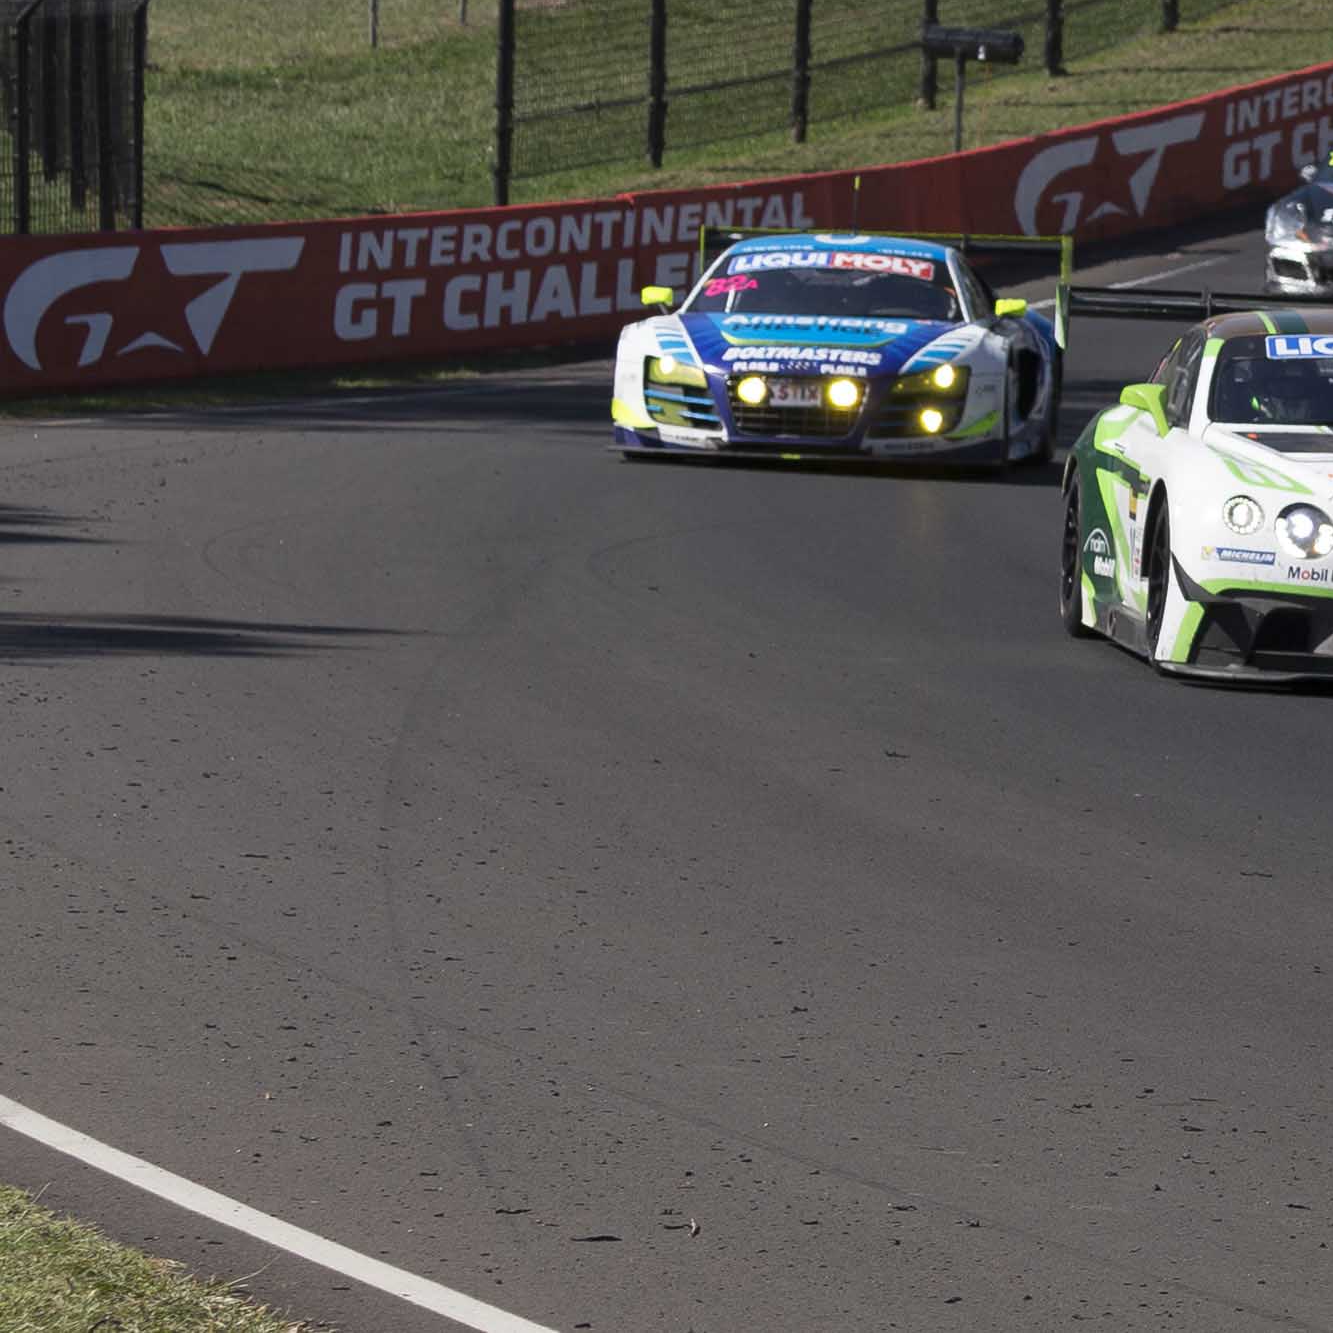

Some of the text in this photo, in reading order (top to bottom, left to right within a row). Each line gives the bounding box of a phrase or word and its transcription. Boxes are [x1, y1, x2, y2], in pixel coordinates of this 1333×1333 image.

[1222, 131, 1283, 190] GT
[339, 192, 814, 273] INTERCONTINENTAL
[734, 251, 827, 270] LIQUI
[833, 252, 932, 279] MOLY
[333, 250, 702, 341] GT CHALLE
[721, 346, 882, 366] BOLTMASTERS
[1288, 566, 1328, 582] Mobil
